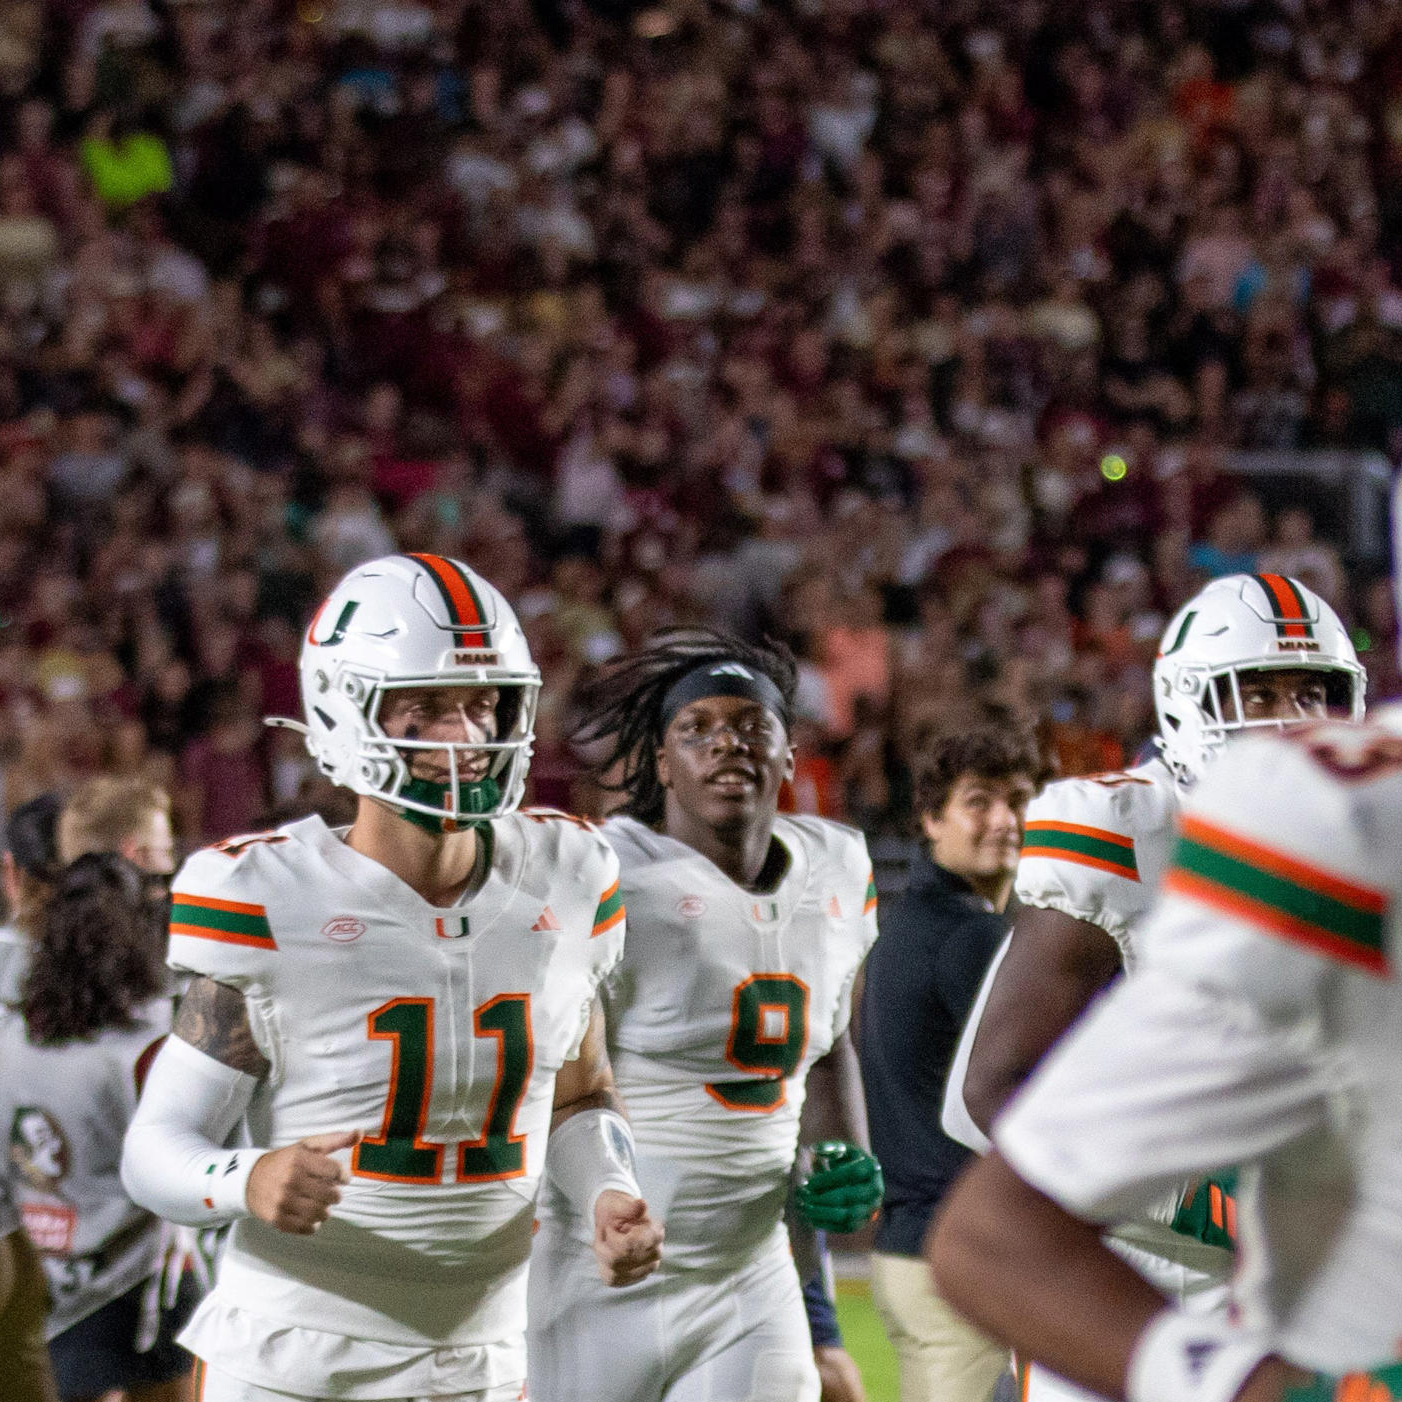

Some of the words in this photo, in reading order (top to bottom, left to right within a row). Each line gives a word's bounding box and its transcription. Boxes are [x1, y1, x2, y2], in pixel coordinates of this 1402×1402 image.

[308, 599, 361, 648] U
[453, 652, 499, 666] MIAMI
[1278, 640, 1320, 652] MIAMI
[435, 916, 470, 939] U
[706, 972, 811, 1114] 9
[350, 992, 535, 1186] 11
